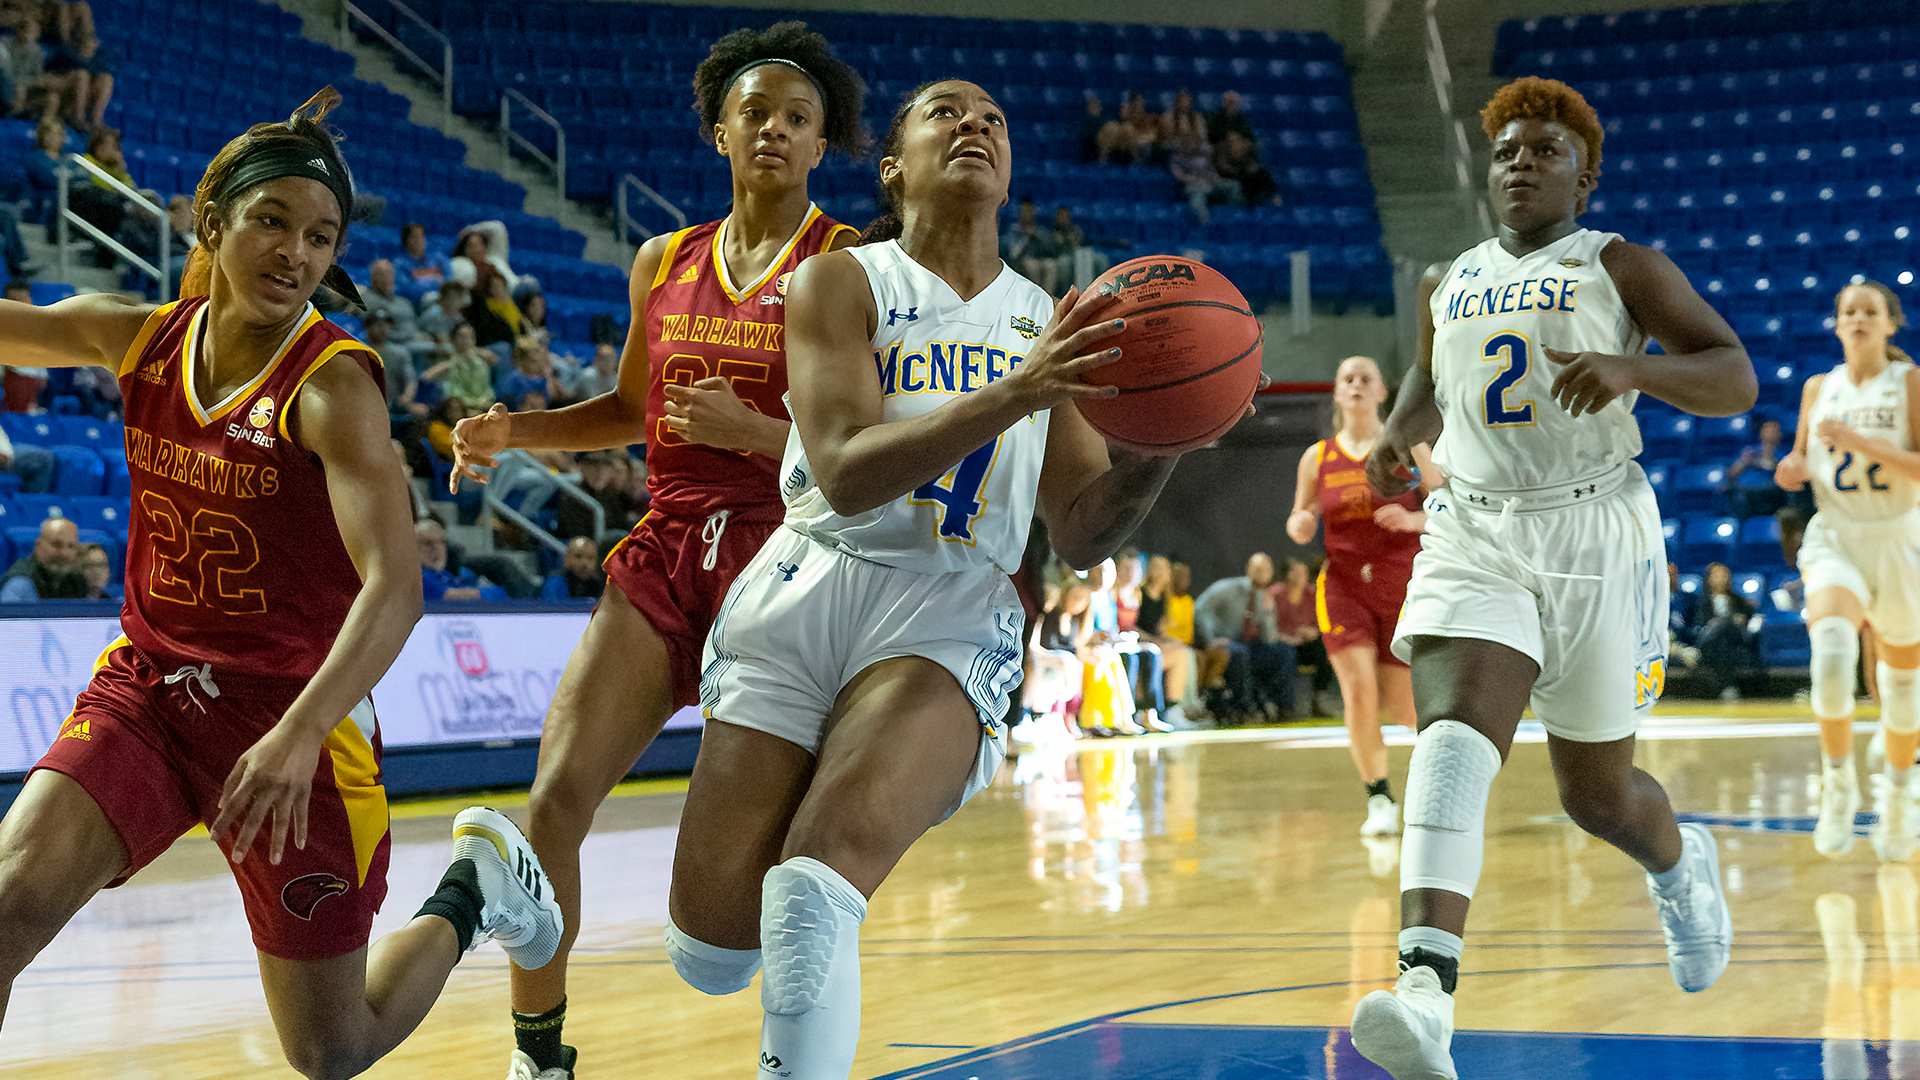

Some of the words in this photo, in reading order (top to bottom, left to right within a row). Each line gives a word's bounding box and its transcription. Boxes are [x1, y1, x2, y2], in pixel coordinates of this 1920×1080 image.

[660, 313, 783, 352] WARHAWK
[872, 339, 1028, 398] McNEE
[1481, 329, 1537, 429] 2
[125, 426, 279, 498] WARHAWKS
[251, 430, 276, 448] BELT
[907, 432, 1004, 547] 4
[141, 489, 267, 615] 22
